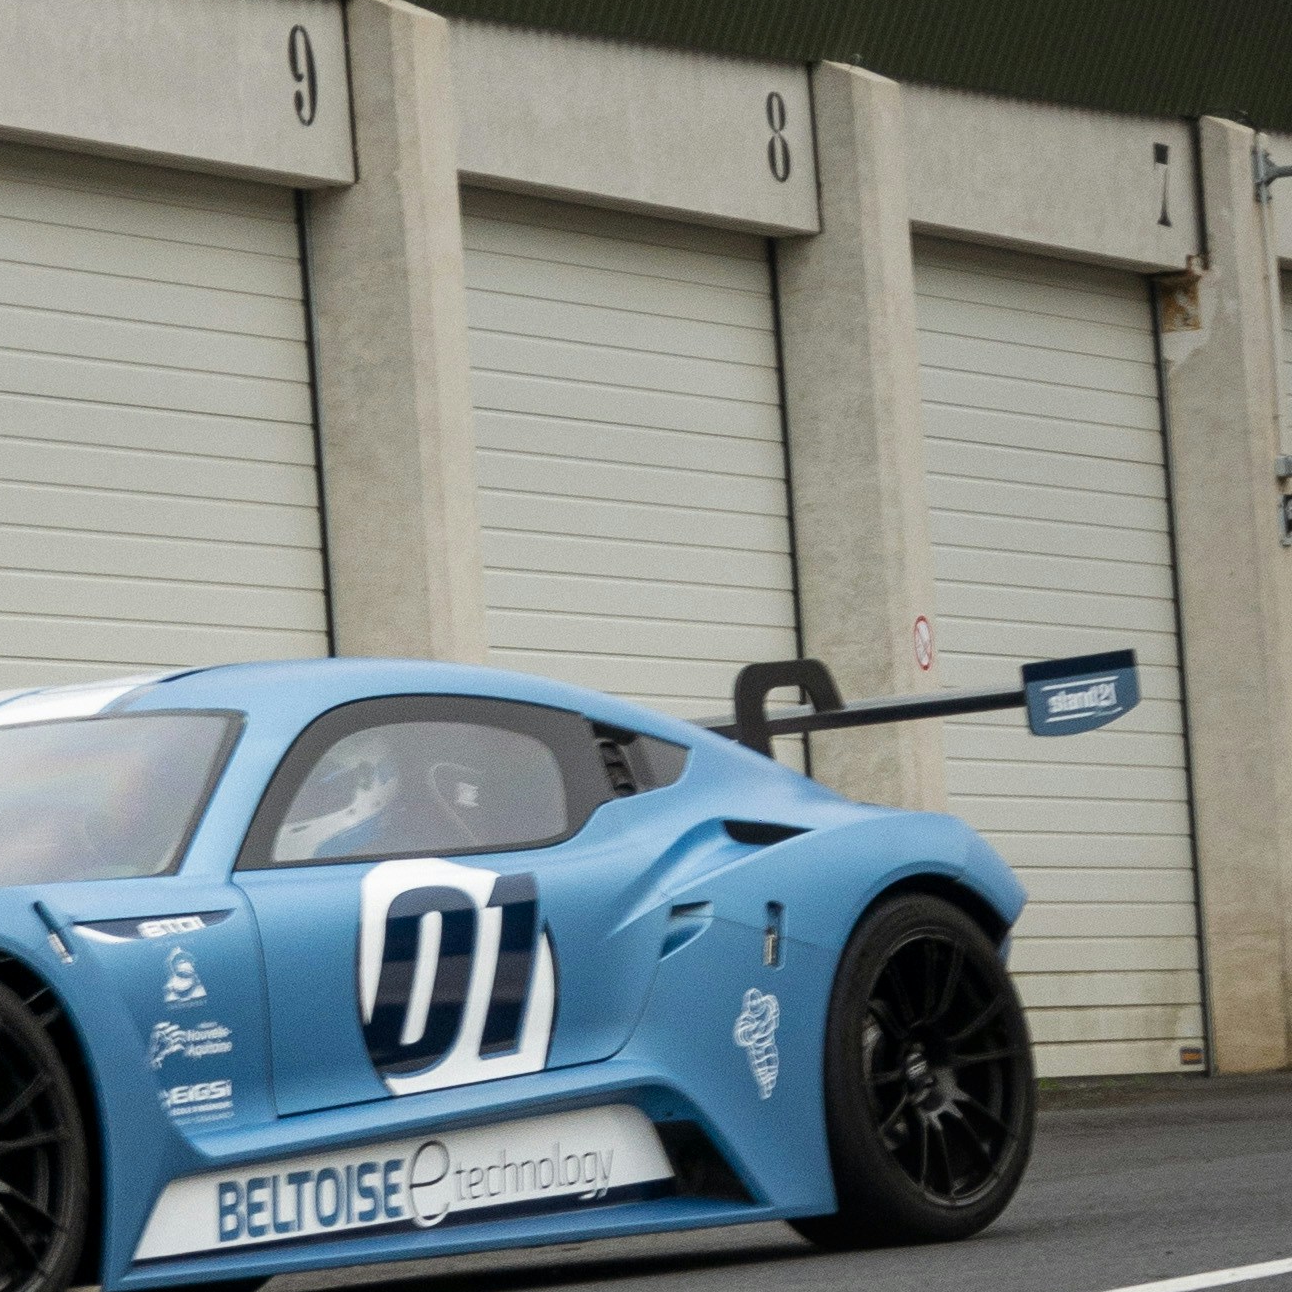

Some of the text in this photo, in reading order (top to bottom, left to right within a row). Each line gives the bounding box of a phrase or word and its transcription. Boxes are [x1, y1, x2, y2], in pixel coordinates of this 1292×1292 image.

[288, 24, 317, 127] 9
[766, 91, 790, 183] 8
[1154, 142, 1172, 227] 7
[363, 872, 537, 1075] 01
[218, 1158, 406, 1242] BELTOISE
